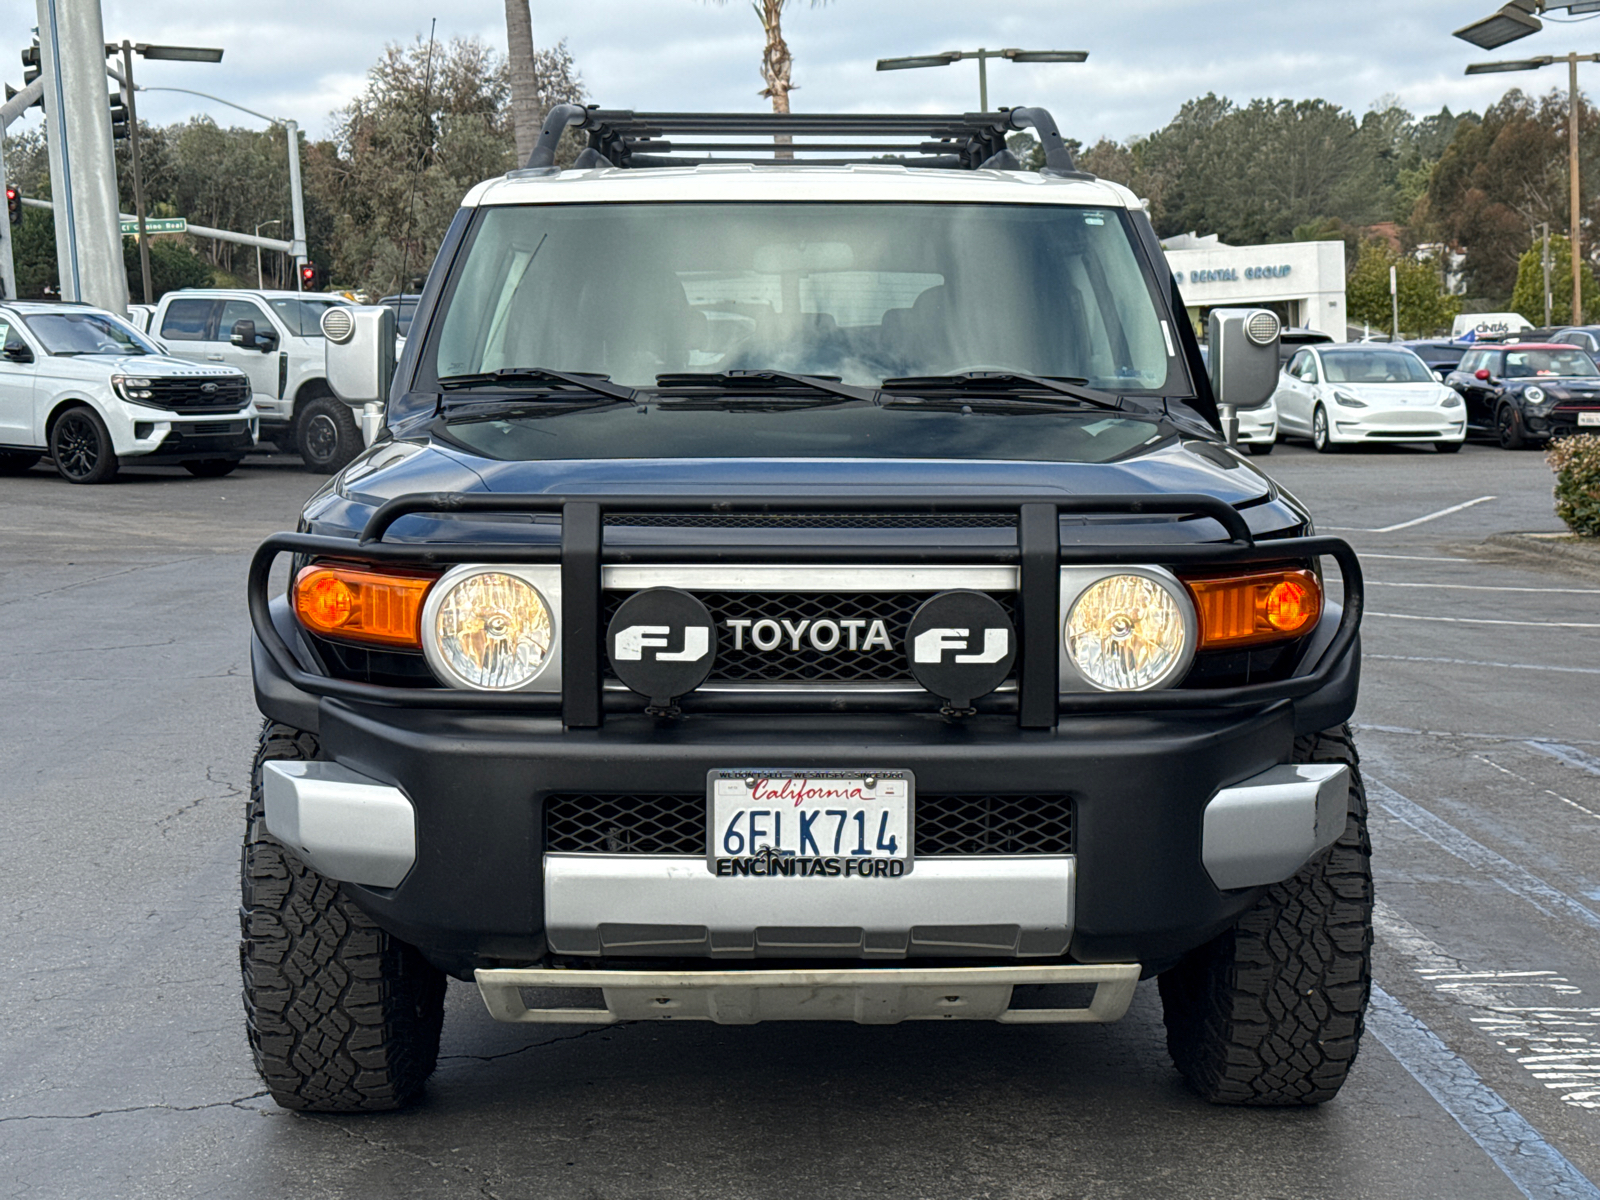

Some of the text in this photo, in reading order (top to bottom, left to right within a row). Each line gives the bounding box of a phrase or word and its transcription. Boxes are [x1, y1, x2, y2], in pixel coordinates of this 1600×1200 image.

[1190, 268, 1239, 283] DENTAL
[1244, 264, 1292, 281] GROUP
[615, 625, 709, 661] FJ
[726, 619, 893, 651] TOYOTA
[914, 628, 1008, 663] FJ
[752, 779, 876, 807] California
[723, 810, 898, 855] 6ELK714
[716, 857, 904, 877] ENCINITAS FORD
